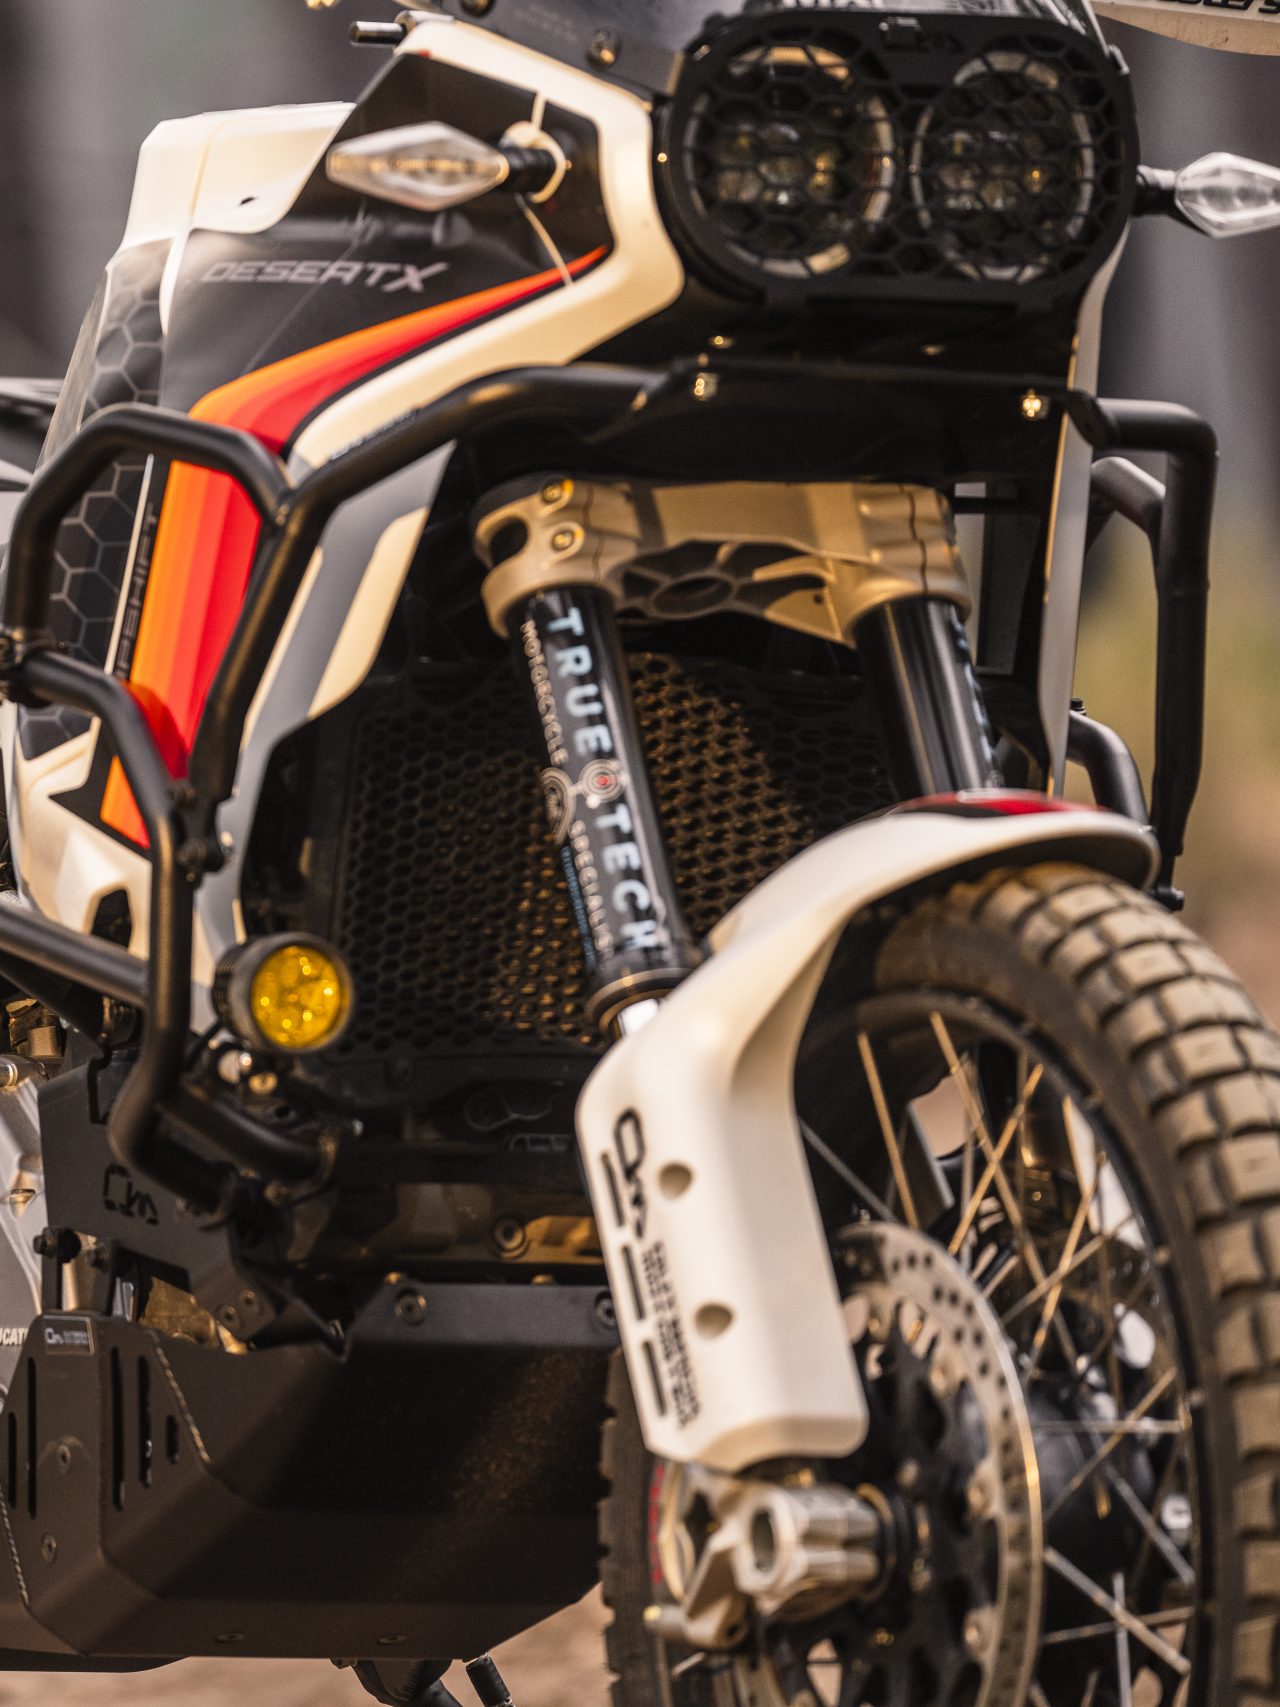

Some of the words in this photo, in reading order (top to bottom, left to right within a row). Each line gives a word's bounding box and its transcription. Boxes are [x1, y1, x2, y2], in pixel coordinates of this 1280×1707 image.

[201, 260, 449, 293] DESERTX
[546, 607, 612, 757] TRUE
[595, 803, 657, 951] TECH
